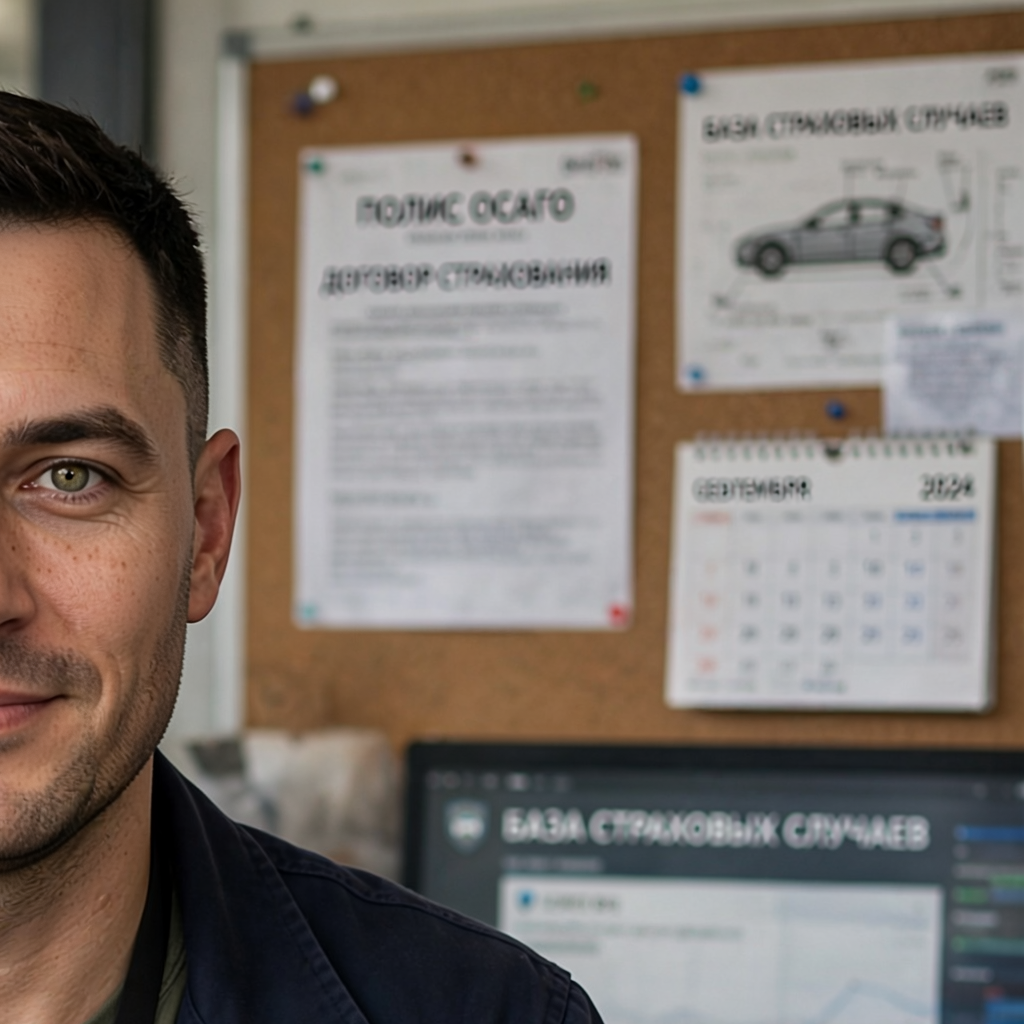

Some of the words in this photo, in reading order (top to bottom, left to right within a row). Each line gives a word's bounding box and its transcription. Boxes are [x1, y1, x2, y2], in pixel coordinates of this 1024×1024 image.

[356, 192, 465, 228] ПОЛИС
[468, 188, 575, 225] ОСАГО
[319, 263, 434, 299] ДОГОВОР
[436, 257, 613, 292] СТРАХОВАНИЯ
[501, 807, 586, 845] БАЗА
[589, 808, 780, 848] СТРАХОВЫХ
[781, 812, 931, 851] СЛУЧАЕВ
